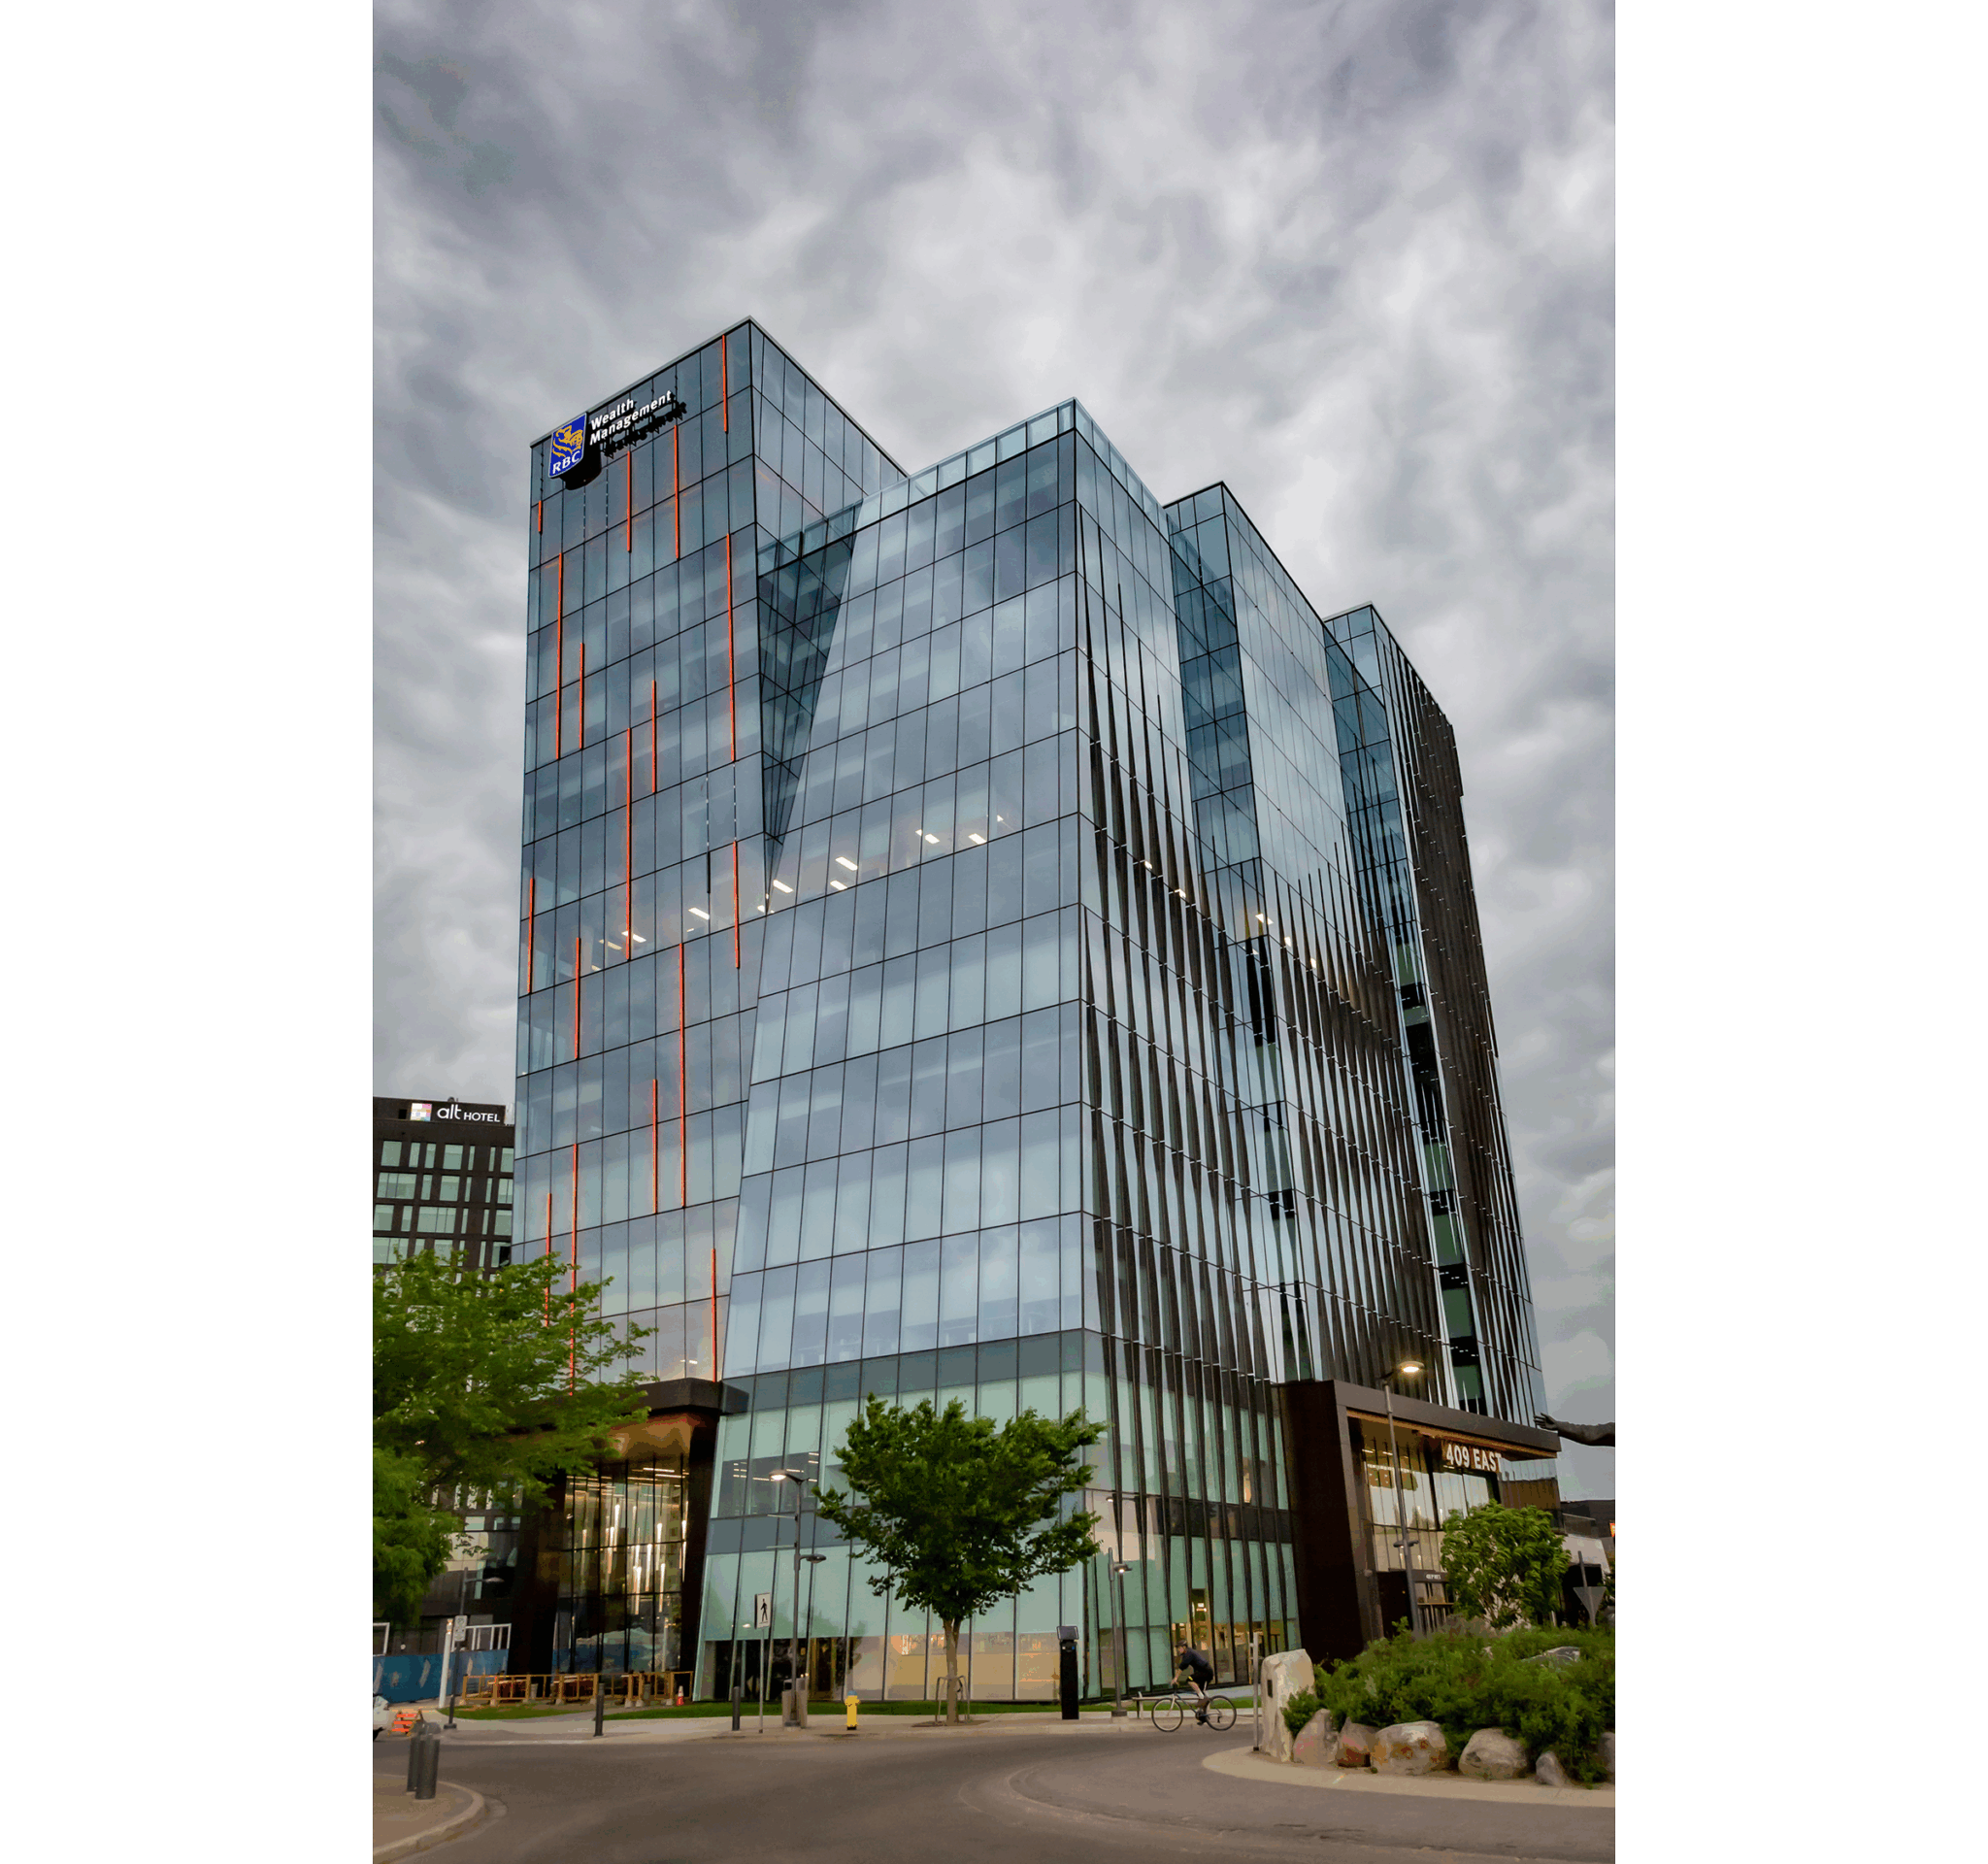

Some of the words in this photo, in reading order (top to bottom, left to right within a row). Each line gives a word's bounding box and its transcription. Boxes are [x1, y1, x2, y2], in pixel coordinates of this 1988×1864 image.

[589, 390, 672, 446] Management
[590, 398, 635, 431] Wealth
[551, 450, 581, 475] RBC
[436, 1103, 462, 1120] alt
[463, 1112, 501, 1122] HOTEL
[1446, 1444, 1471, 1469] 409
[1473, 1448, 1502, 1473] EAST
